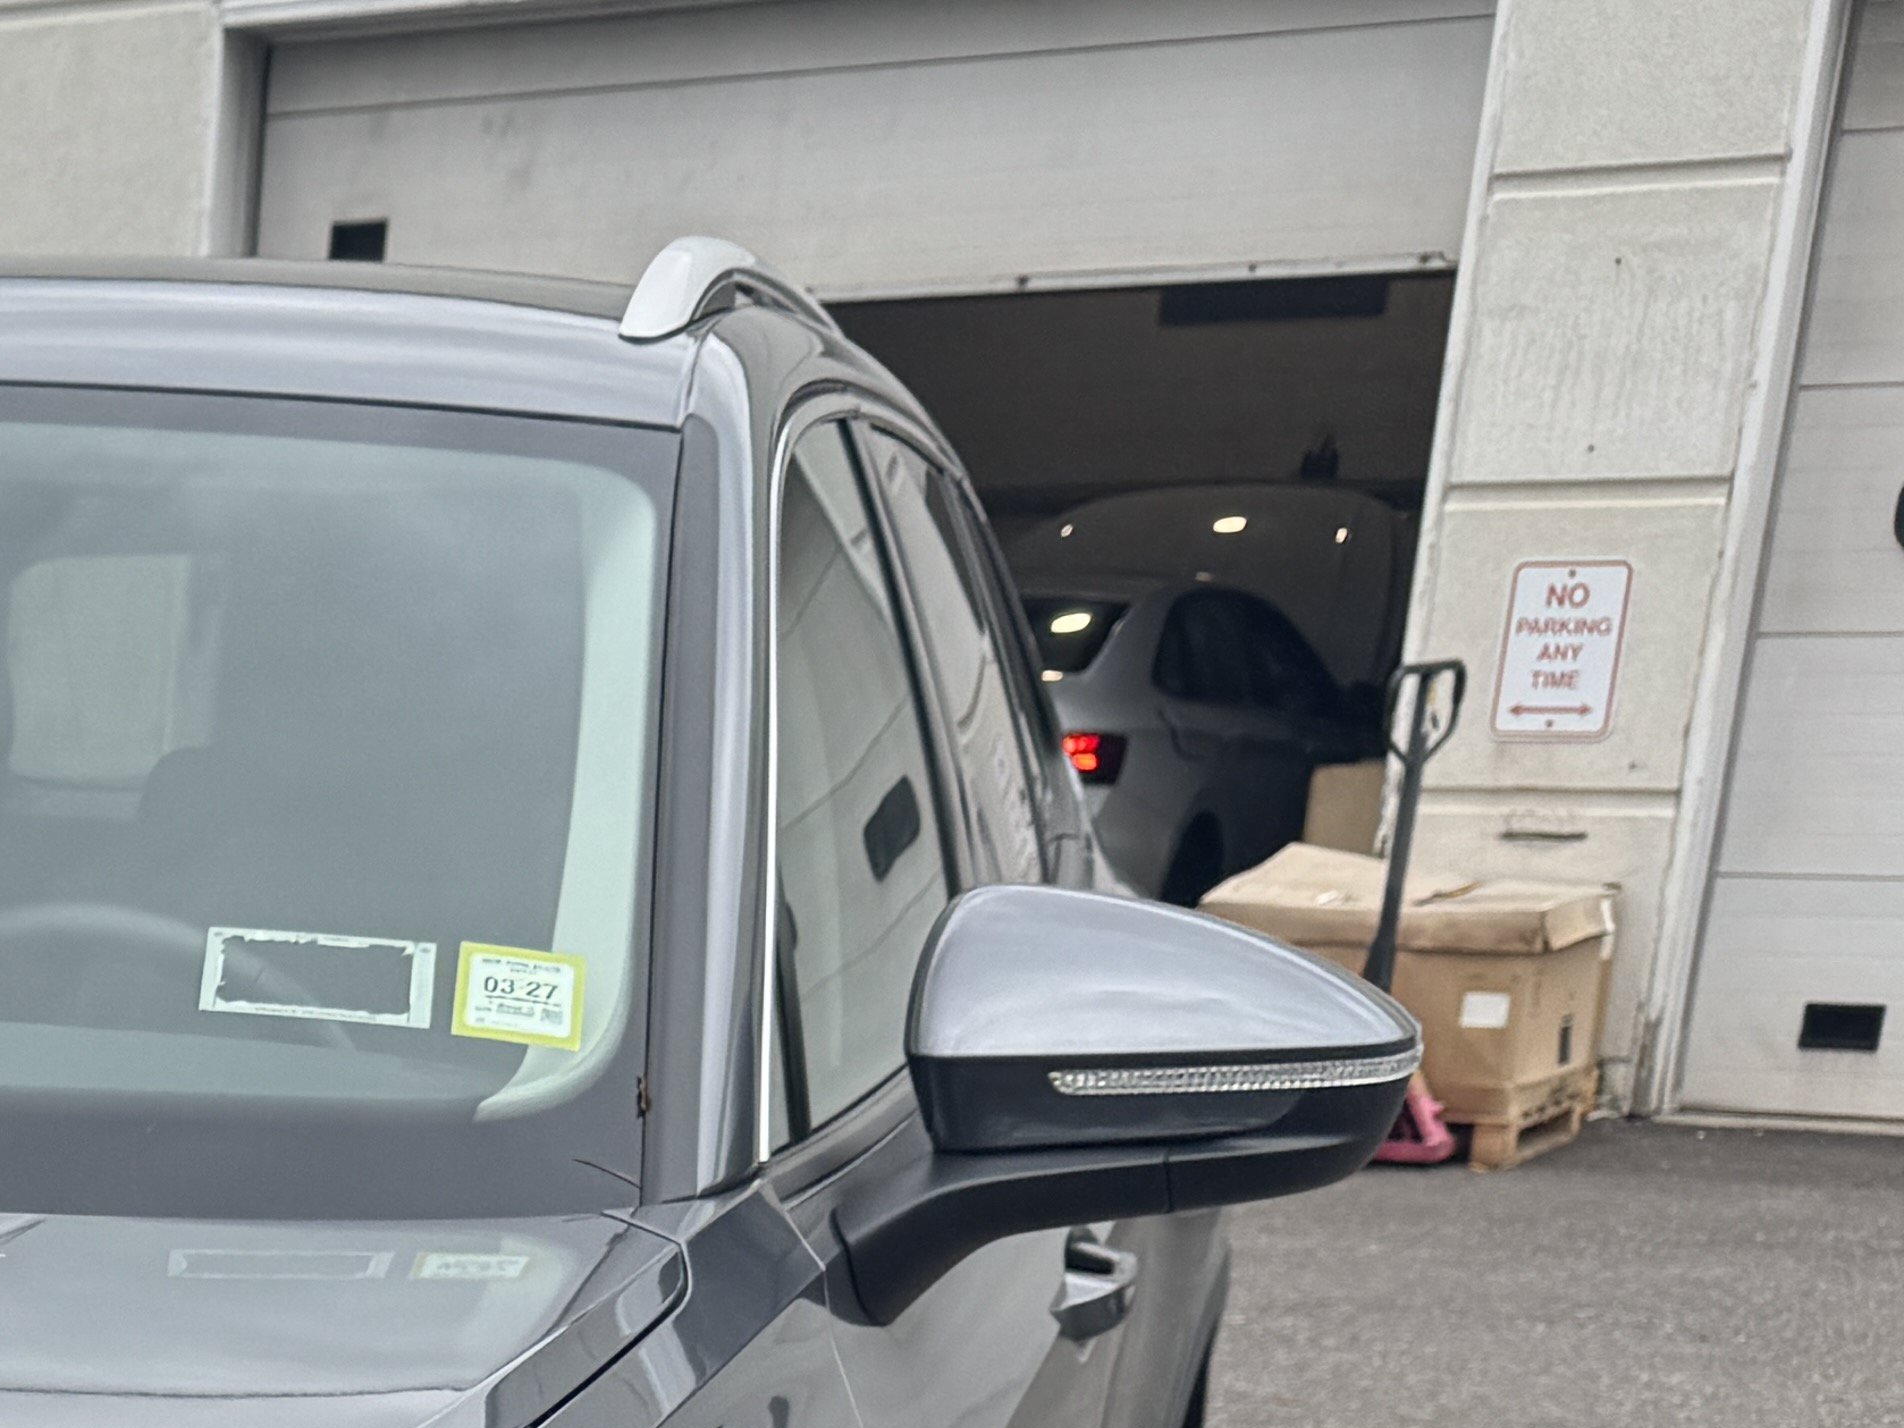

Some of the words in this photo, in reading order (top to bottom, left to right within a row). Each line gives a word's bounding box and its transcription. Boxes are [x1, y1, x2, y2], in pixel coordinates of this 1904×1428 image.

[1546, 582, 1590, 608] NO
[1515, 616, 1612, 638] PARKING
[1536, 643, 1583, 662] ANY
[1530, 669, 1580, 690] TIME
